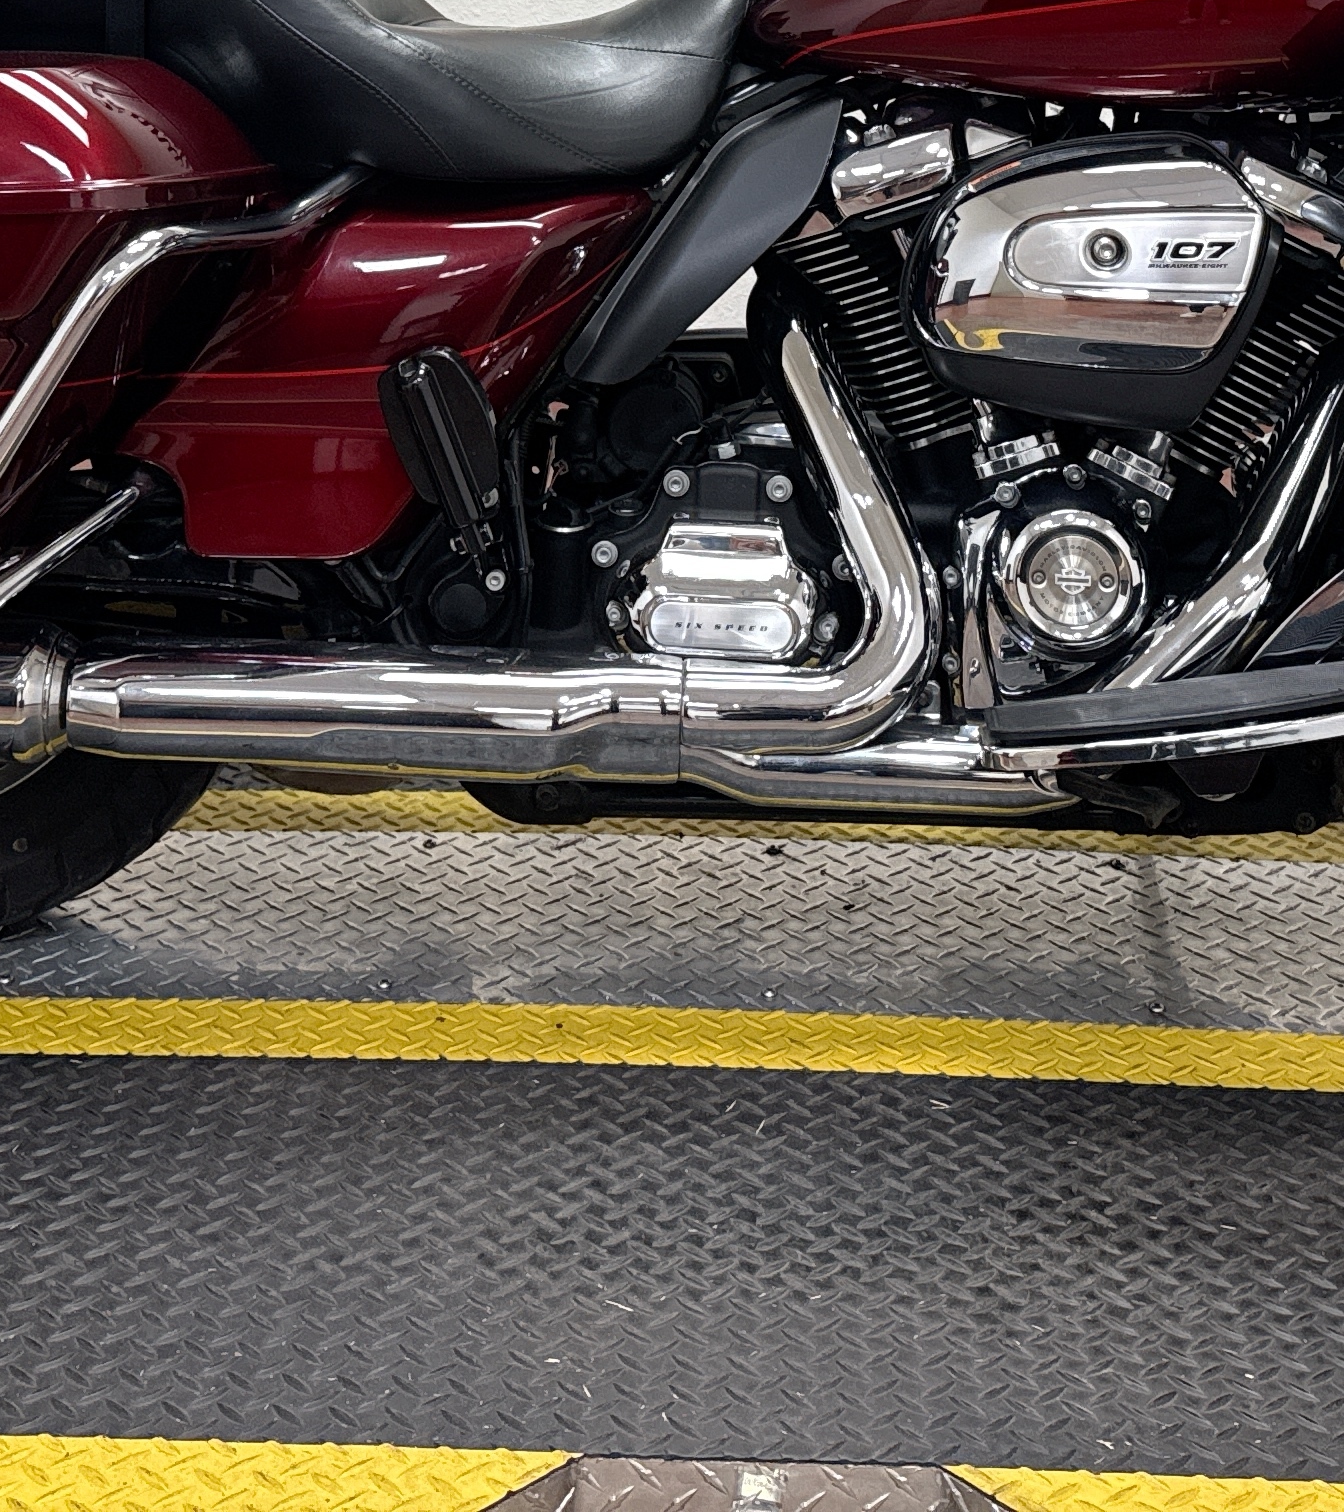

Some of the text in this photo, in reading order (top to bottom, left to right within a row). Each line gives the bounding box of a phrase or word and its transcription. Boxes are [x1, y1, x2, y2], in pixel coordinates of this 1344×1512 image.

[1151, 239, 1240, 261] 107
[675, 621, 769, 631] SIX SPEED
